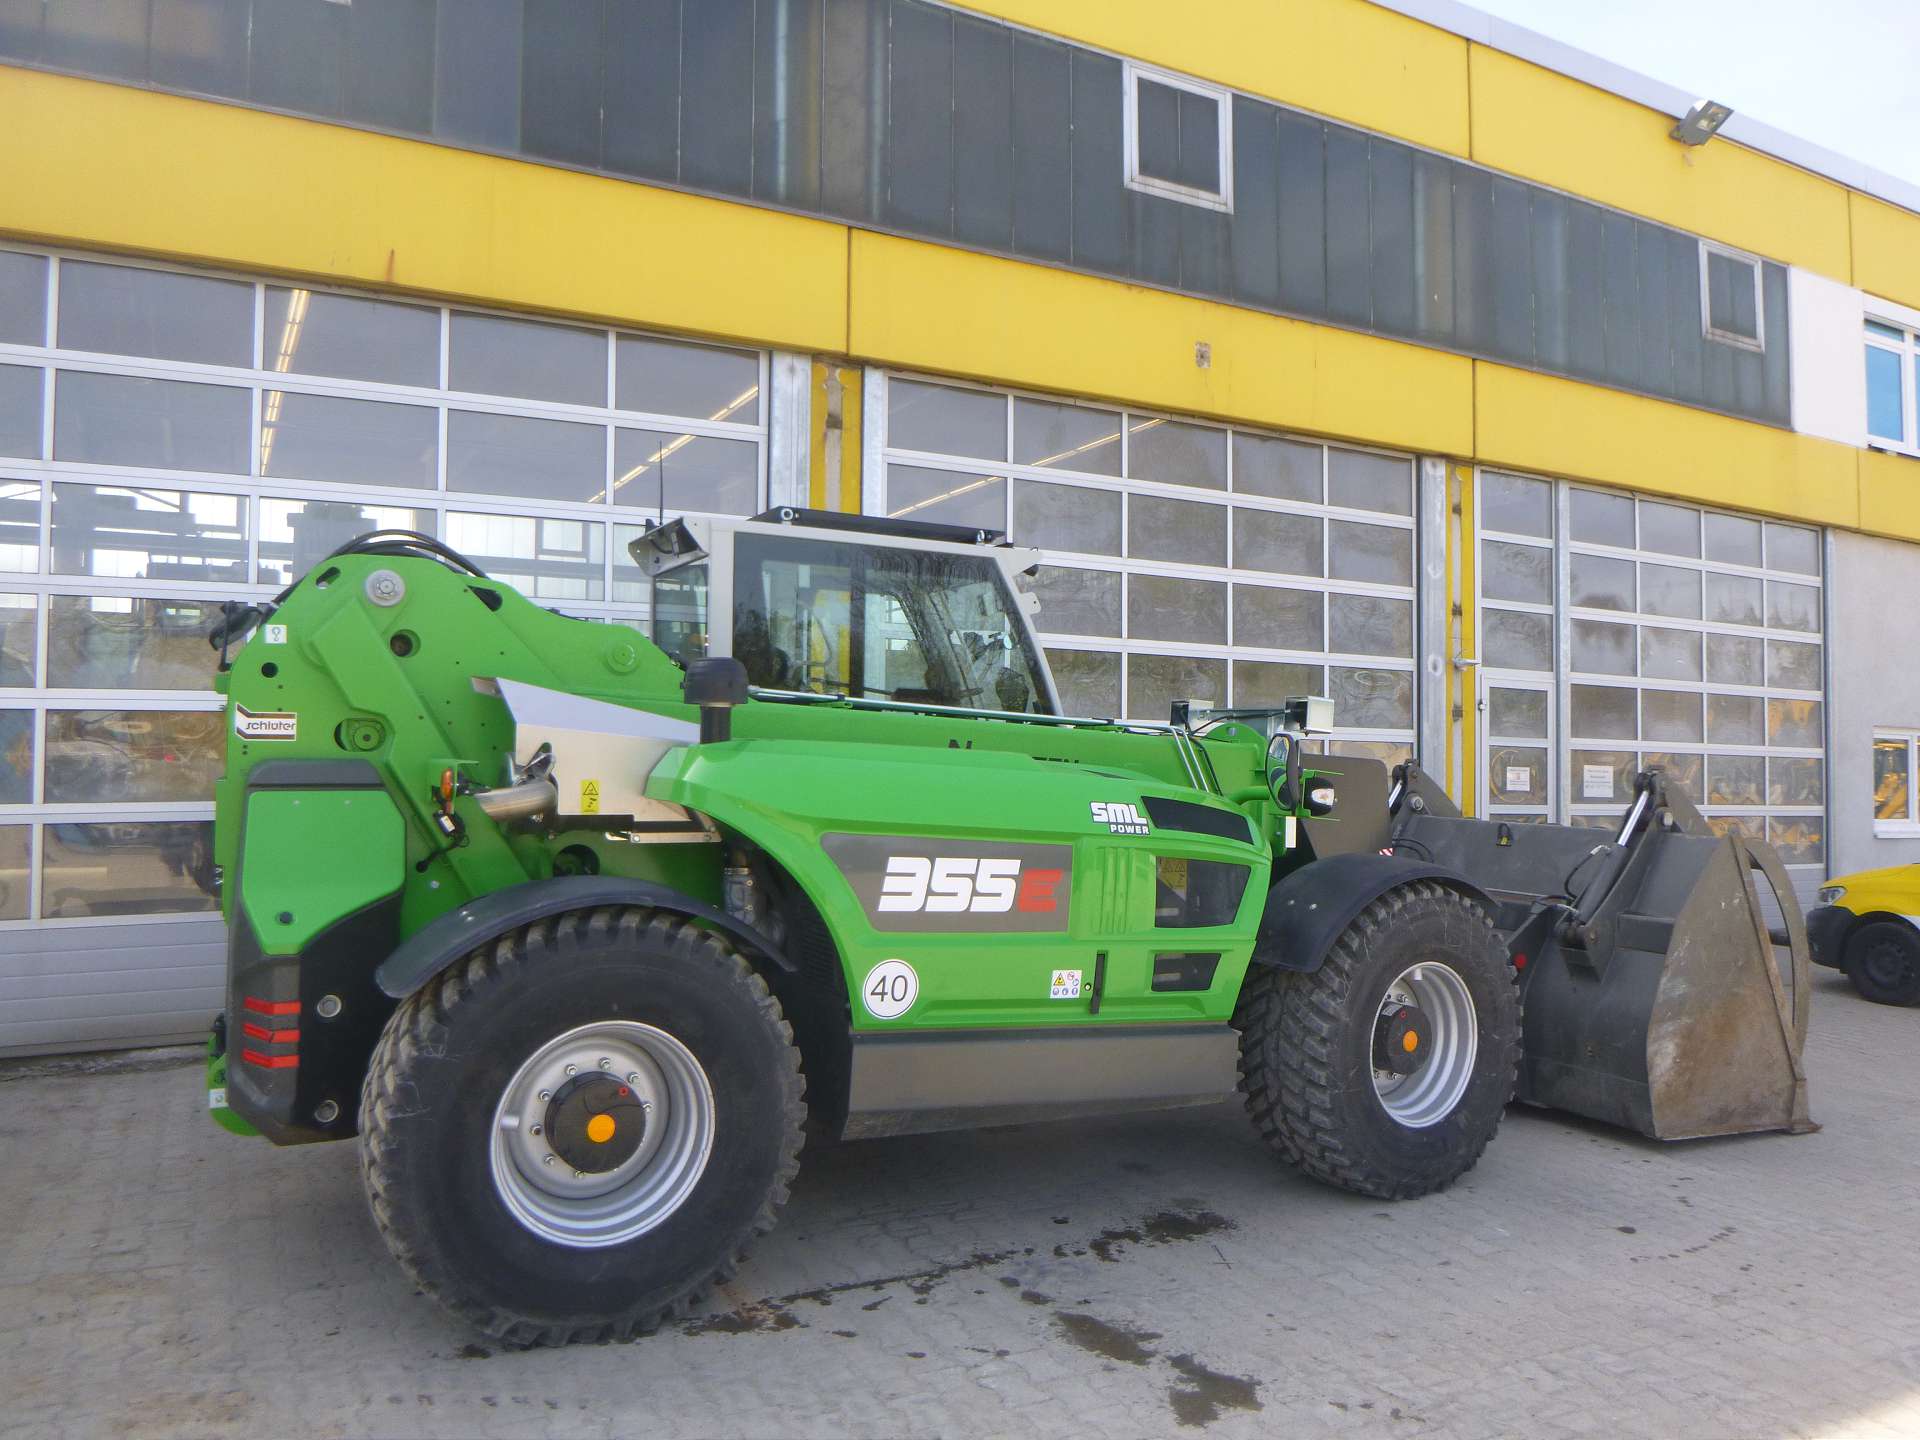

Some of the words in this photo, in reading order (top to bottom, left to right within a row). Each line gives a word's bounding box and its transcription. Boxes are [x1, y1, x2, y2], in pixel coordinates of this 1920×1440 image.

[1090, 802, 1148, 825] SML
[1109, 824, 1150, 835] POWER
[870, 974, 909, 1003] 40
